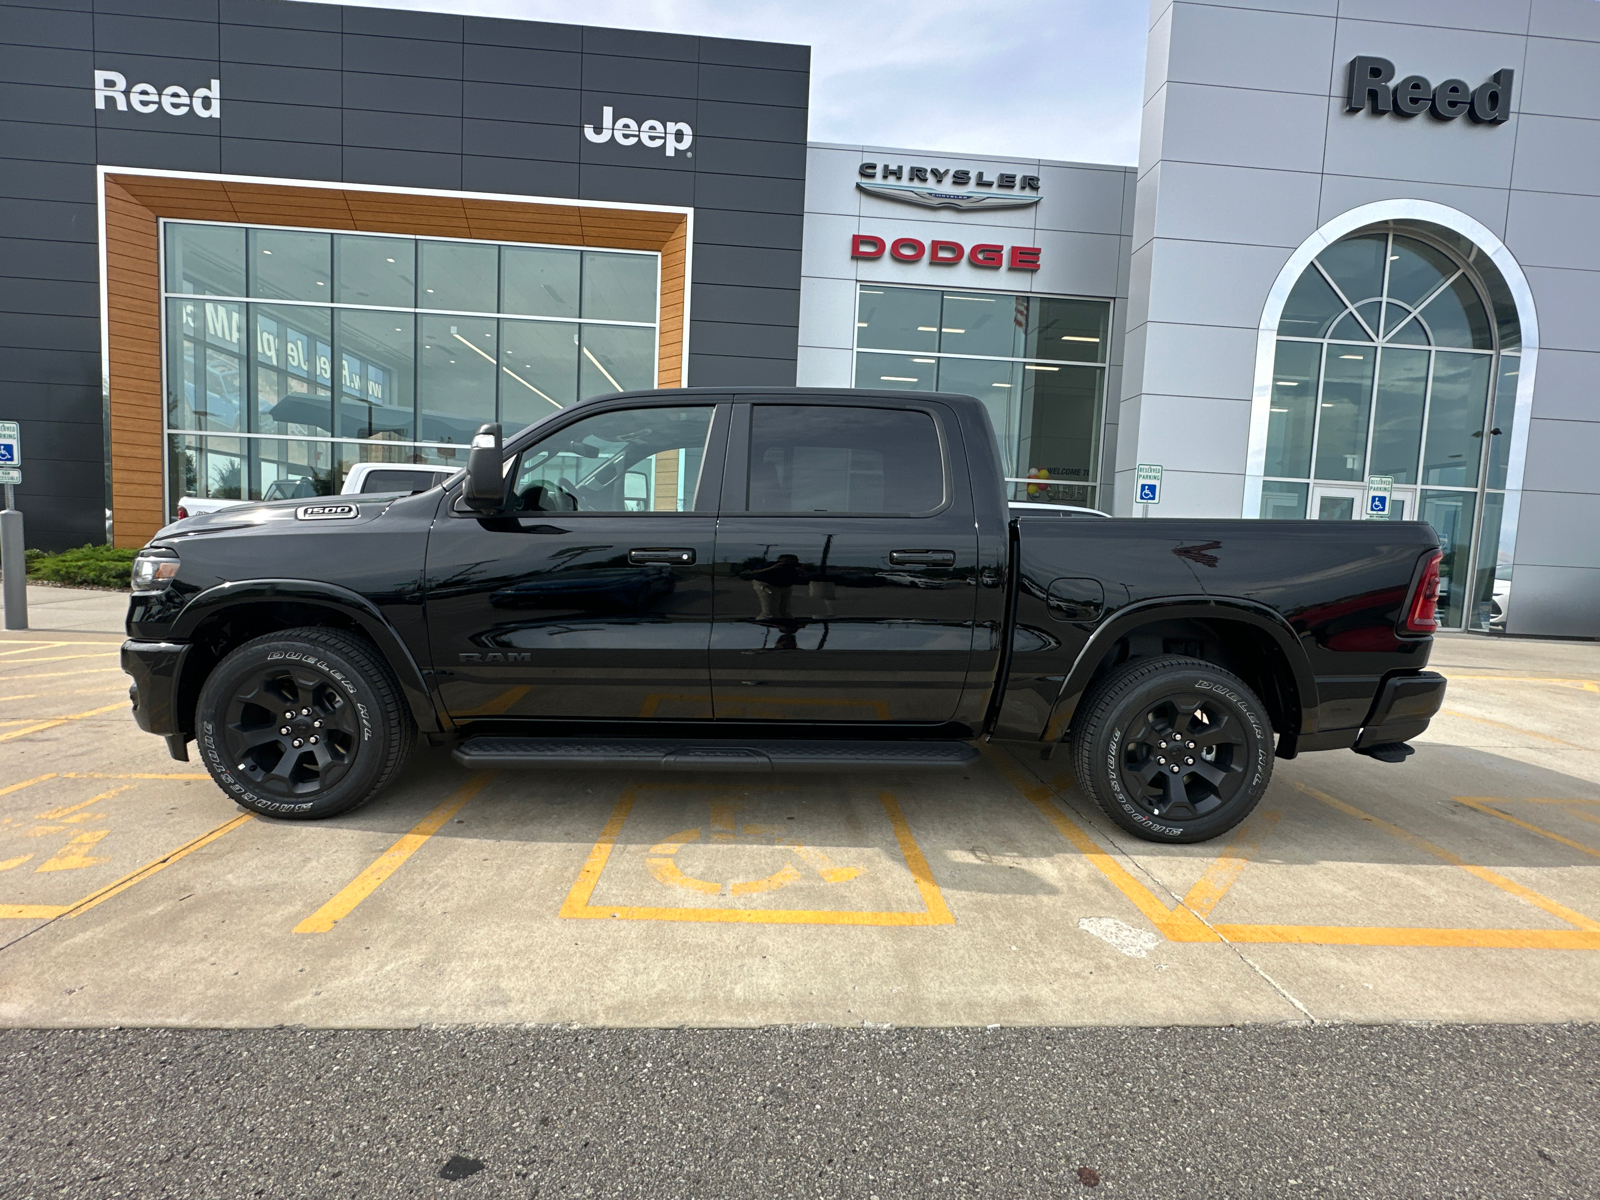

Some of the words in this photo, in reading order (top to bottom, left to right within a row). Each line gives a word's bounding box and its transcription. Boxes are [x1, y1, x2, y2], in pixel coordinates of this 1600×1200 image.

[94, 69, 220, 118] Reed
[1346, 55, 1515, 125] Reed
[583, 105, 693, 157] Jeep
[859, 162, 1041, 190] CHRYSLER
[851, 234, 1042, 271] DODGE
[1047, 467, 1081, 476] WELCOME
[306, 506, 349, 514] 1500
[459, 652, 532, 663] RAM
[267, 651, 357, 694] DUELER
[357, 702, 373, 741] H/L
[1195, 679, 1264, 740] DUELER
[1252, 748, 1268, 786] H/L
[203, 720, 314, 813] BRIDGESTONE
[1107, 727, 1184, 837] BRIDGESTONE
